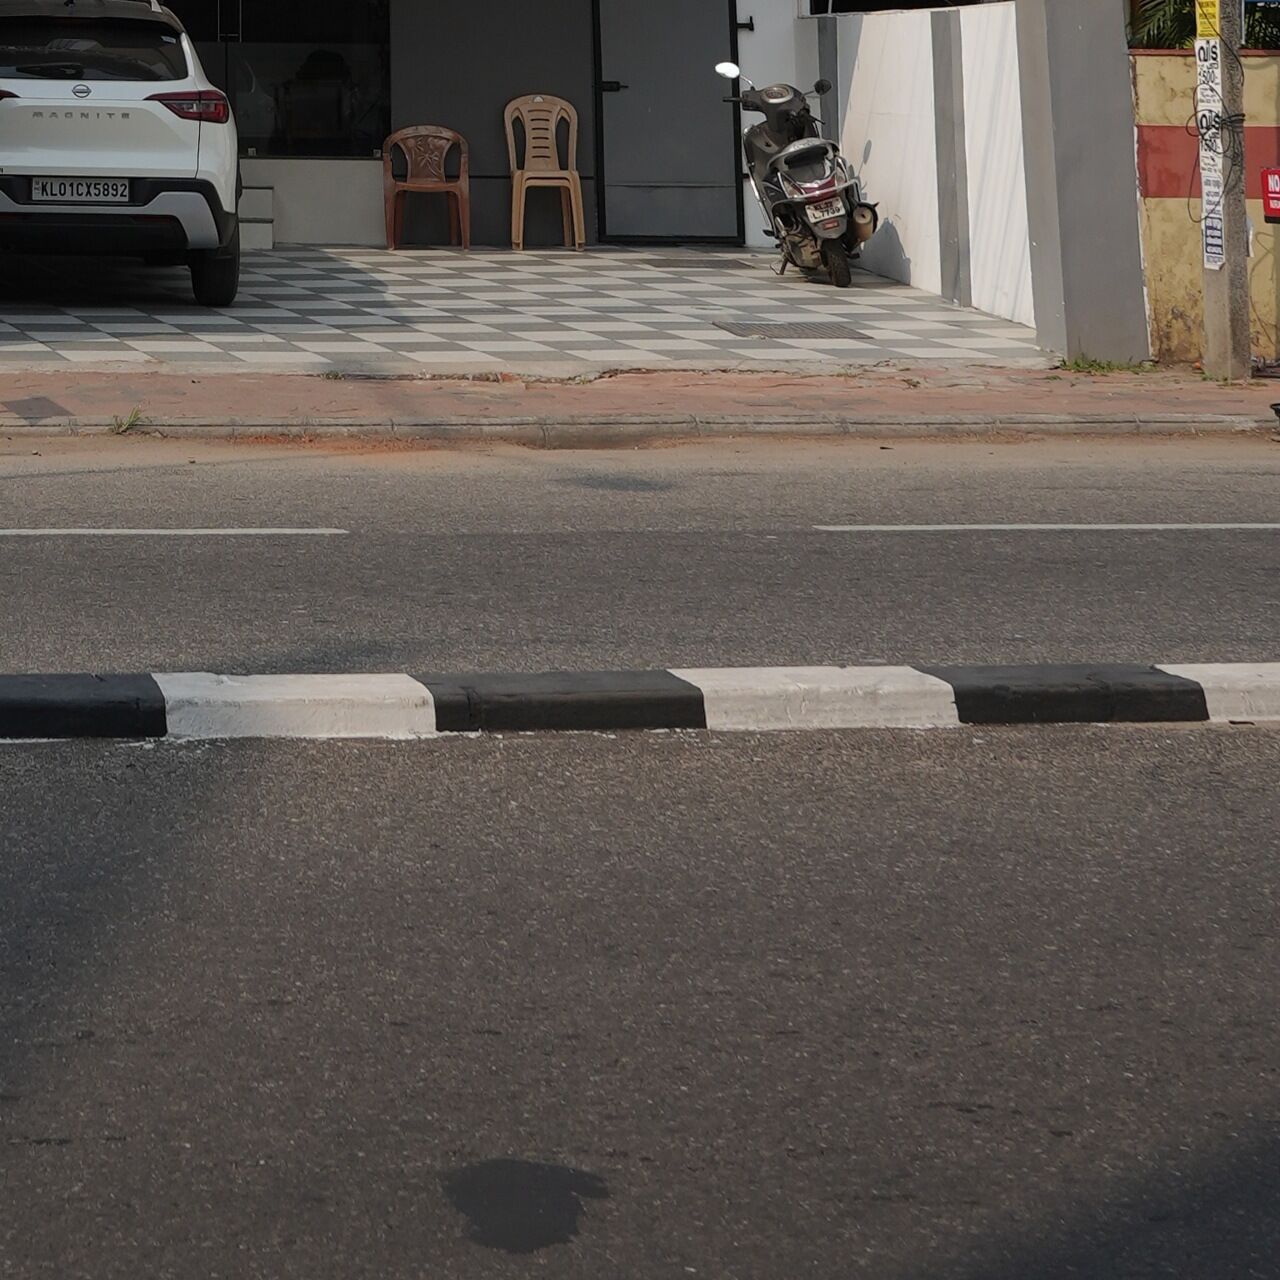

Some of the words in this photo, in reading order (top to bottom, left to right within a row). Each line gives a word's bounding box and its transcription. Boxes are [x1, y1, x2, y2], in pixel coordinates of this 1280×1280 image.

[32, 111, 131, 119] MAGNITE
[41, 182, 128, 198] KL01CX5892
[1267, 174, 1280, 192] NO
